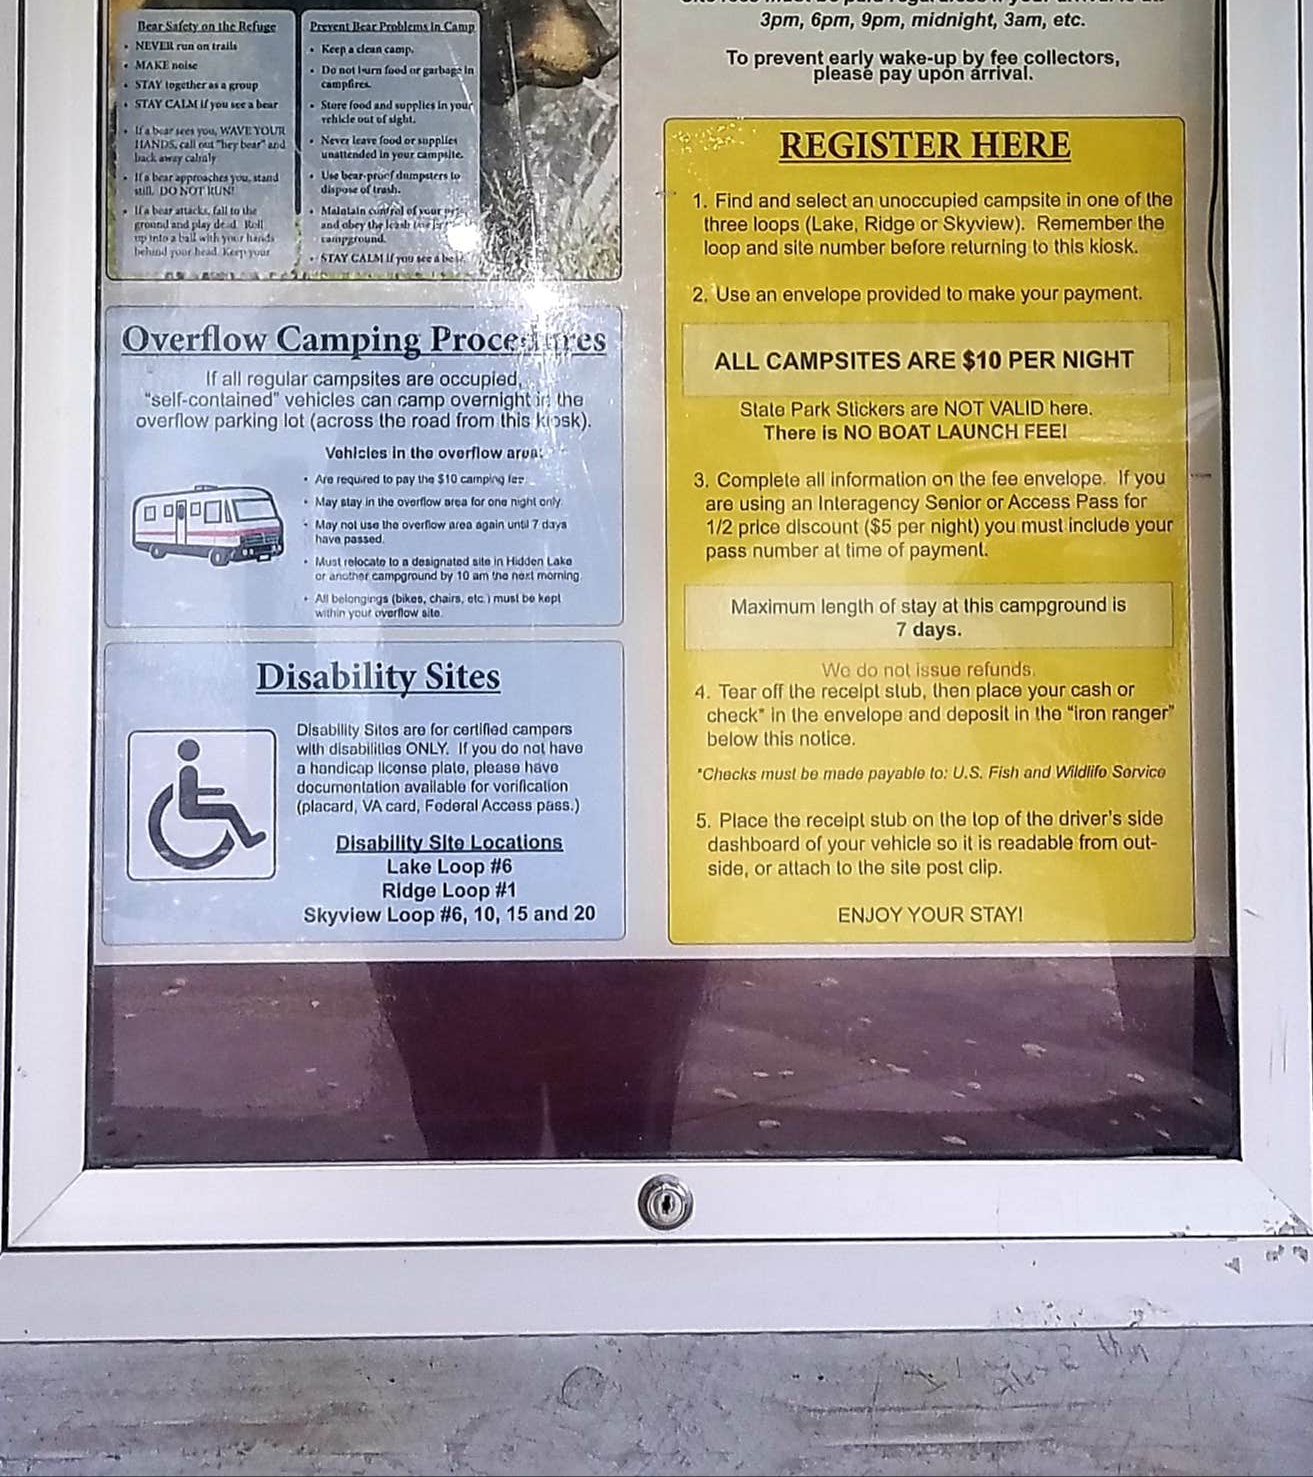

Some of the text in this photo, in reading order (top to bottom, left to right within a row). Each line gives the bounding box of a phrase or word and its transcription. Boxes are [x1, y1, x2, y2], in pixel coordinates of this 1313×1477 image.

[137, 19, 277, 32] Bear Safety on the Refuge
[760, 11, 1086, 31] 3pm, 6pm, 9pm, midnight, 3am, etc.
[135, 40, 238, 51] NEVER run on trails
[321, 43, 415, 57] Keep a clean camp.
[134, 59, 198, 71] MAKE noise
[725, 48, 1120, 69] To prevent early wake-up by fee collectors,
[813, 66, 1034, 85] please pay upon arrival.
[135, 79, 259, 93] STAY together as a group
[779, 130, 1072, 159] REGISTER HERE
[122, 324, 268, 352] Overflow
[277, 324, 421, 358] Camping
[714, 349, 1135, 372] ALL CAMPSITES ARE $10 PER NIGHT
[206, 370, 522, 390] If all regular campsites are occupied,
[315, 496, 338, 510] May
[340, 497, 363, 510] stay
[365, 496, 375, 507] in
[377, 496, 395, 508] the
[396, 496, 442, 507] overflow
[444, 498, 468, 508] area
[470, 496, 486, 507] for
[487, 498, 508, 507] one
[510, 497, 537, 509] night
[731, 595, 1127, 618] Maximum length of stay at this campground is
[896, 621, 962, 641] 7 days.
[822, 660, 1036, 678] We do not issue refunds.
[256, 661, 500, 698] Disability Sites
[336, 833, 564, 851] Disability Site Locations
[387, 857, 513, 878] Lake Loop #6
[382, 881, 515, 902] Ridge Loop #1
[304, 904, 596, 927] Skyview Loop #6, 10, 15 and 20
[838, 905, 1023, 924] ENJOY YOUR STAY!
